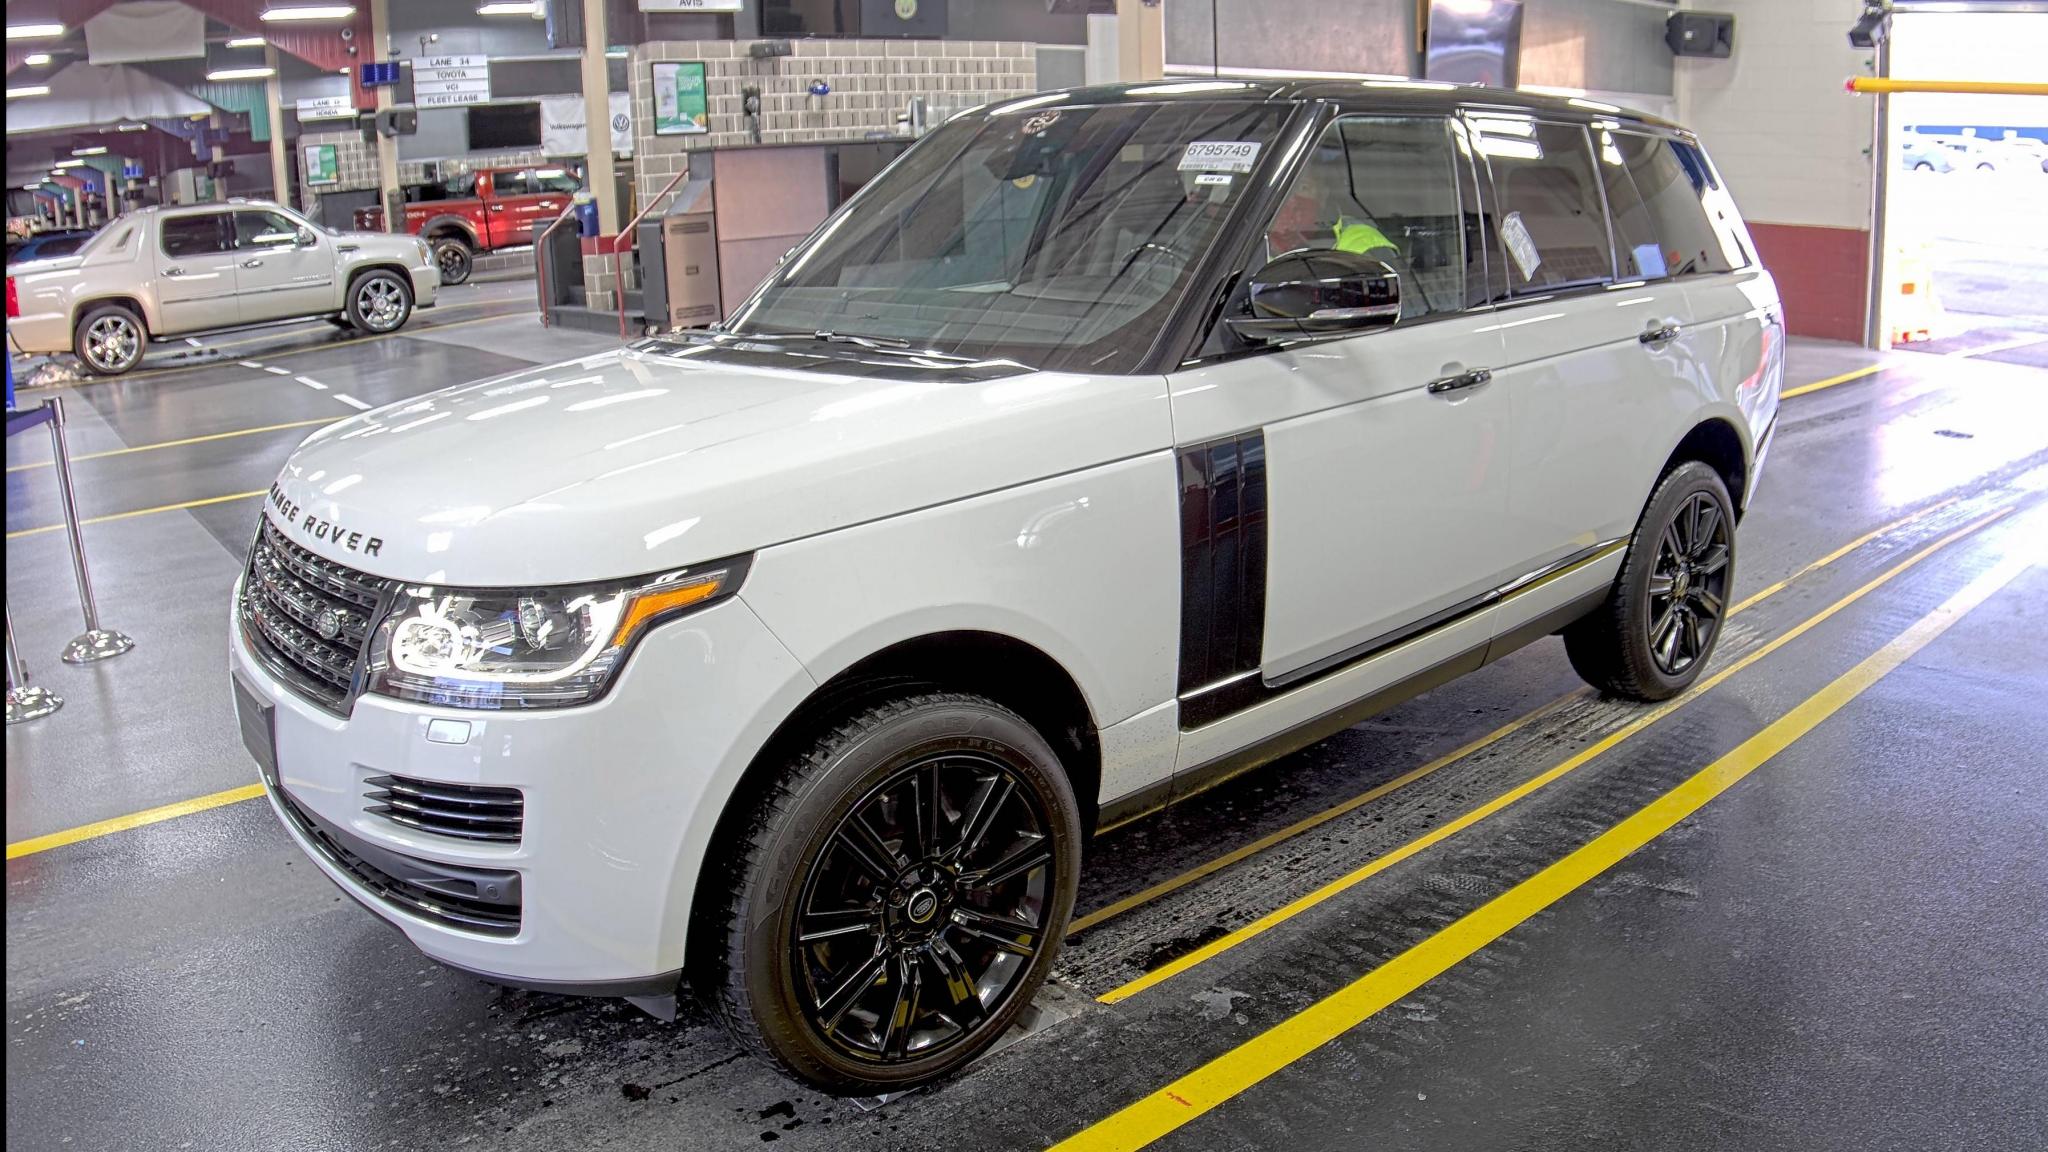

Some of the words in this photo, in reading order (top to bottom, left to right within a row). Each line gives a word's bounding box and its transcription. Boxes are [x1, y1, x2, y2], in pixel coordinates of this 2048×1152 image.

[430, 56, 452, 66] LANE
[437, 71, 467, 79] TOYOTA
[312, 98, 330, 107] LANE
[428, 96, 452, 104] FLEET
[453, 95, 478, 103] LEASE
[1187, 144, 1251, 157] 6795749
[270, 481, 300, 522] RANGE
[303, 515, 384, 557] ROVER
